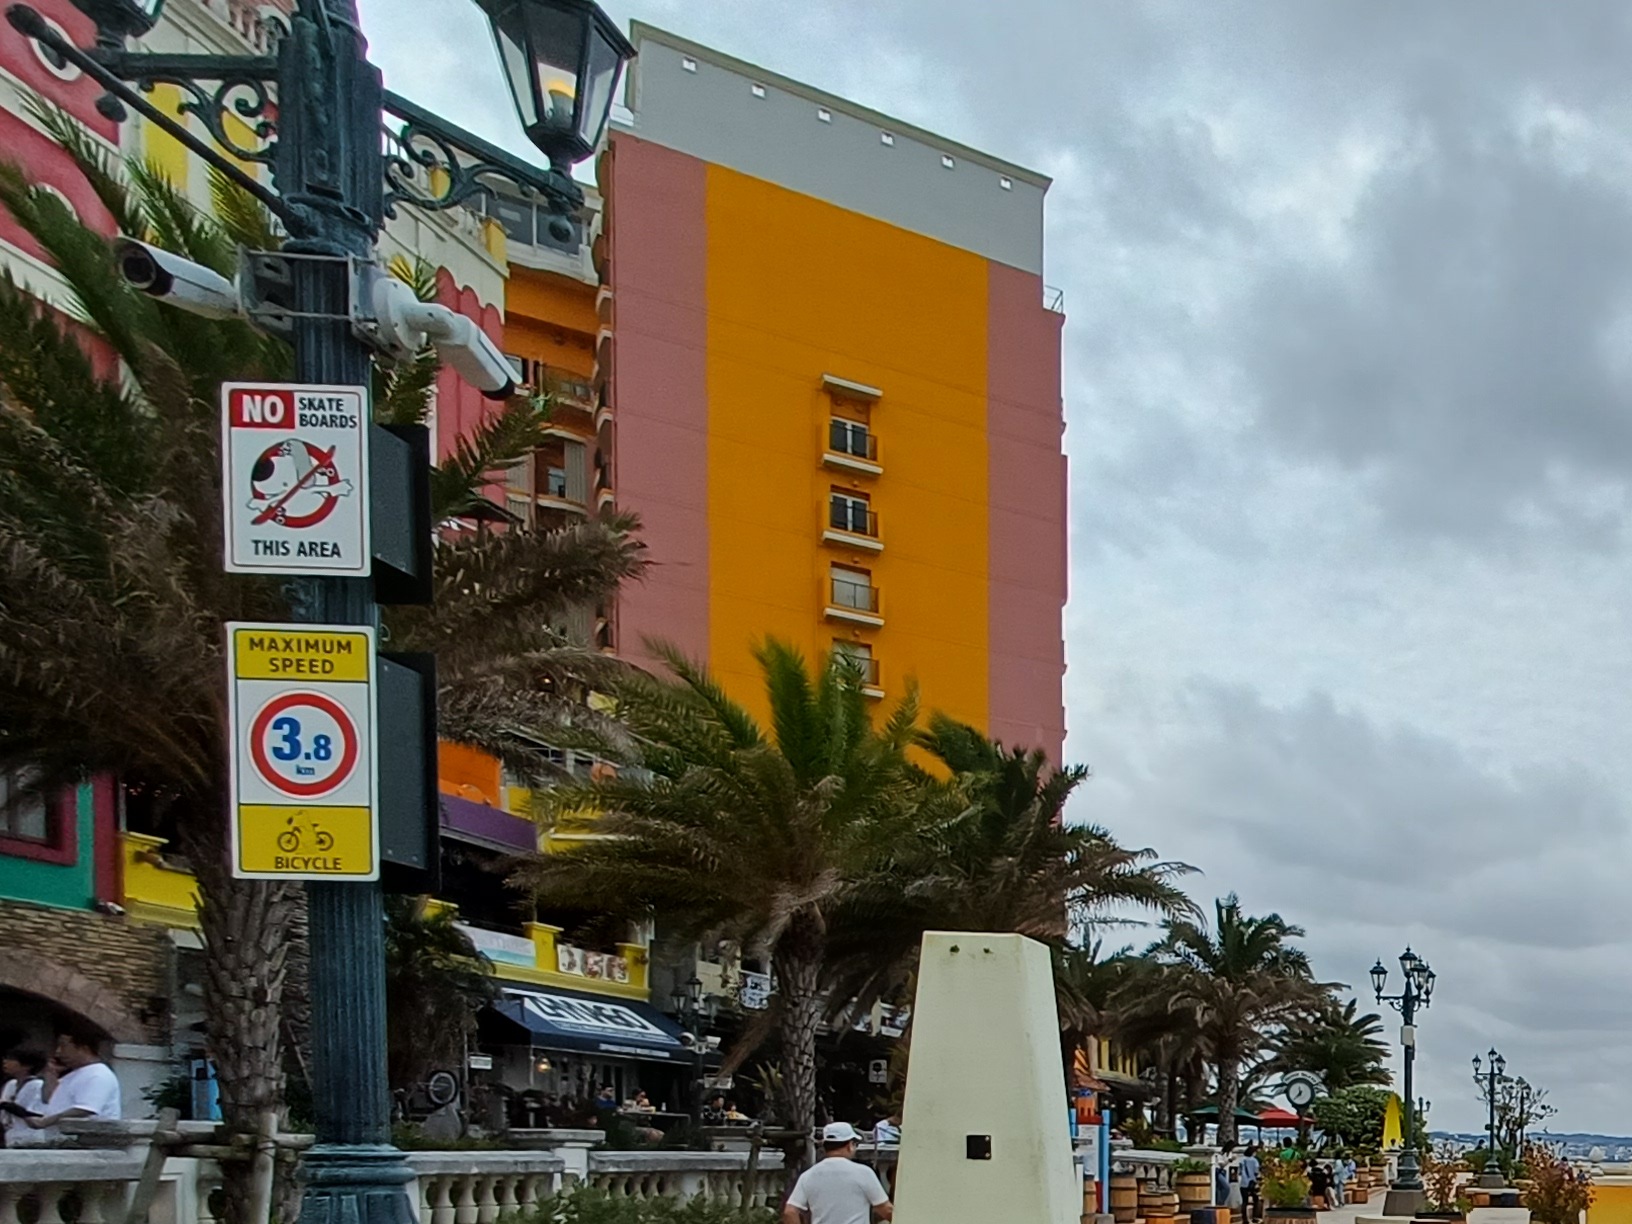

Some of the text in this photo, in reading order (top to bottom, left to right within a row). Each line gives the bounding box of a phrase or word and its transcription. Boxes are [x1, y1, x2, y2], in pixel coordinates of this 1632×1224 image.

[242, 394, 285, 424] NO
[299, 397, 344, 412] SKATE
[299, 413, 357, 429] BOARDS
[251, 539, 342, 558] THIS AREA
[249, 637, 353, 655] MAXIMUM
[269, 657, 335, 674] SPEED
[272, 716, 332, 761] 3.8
[274, 855, 342, 871] BICYCLE
